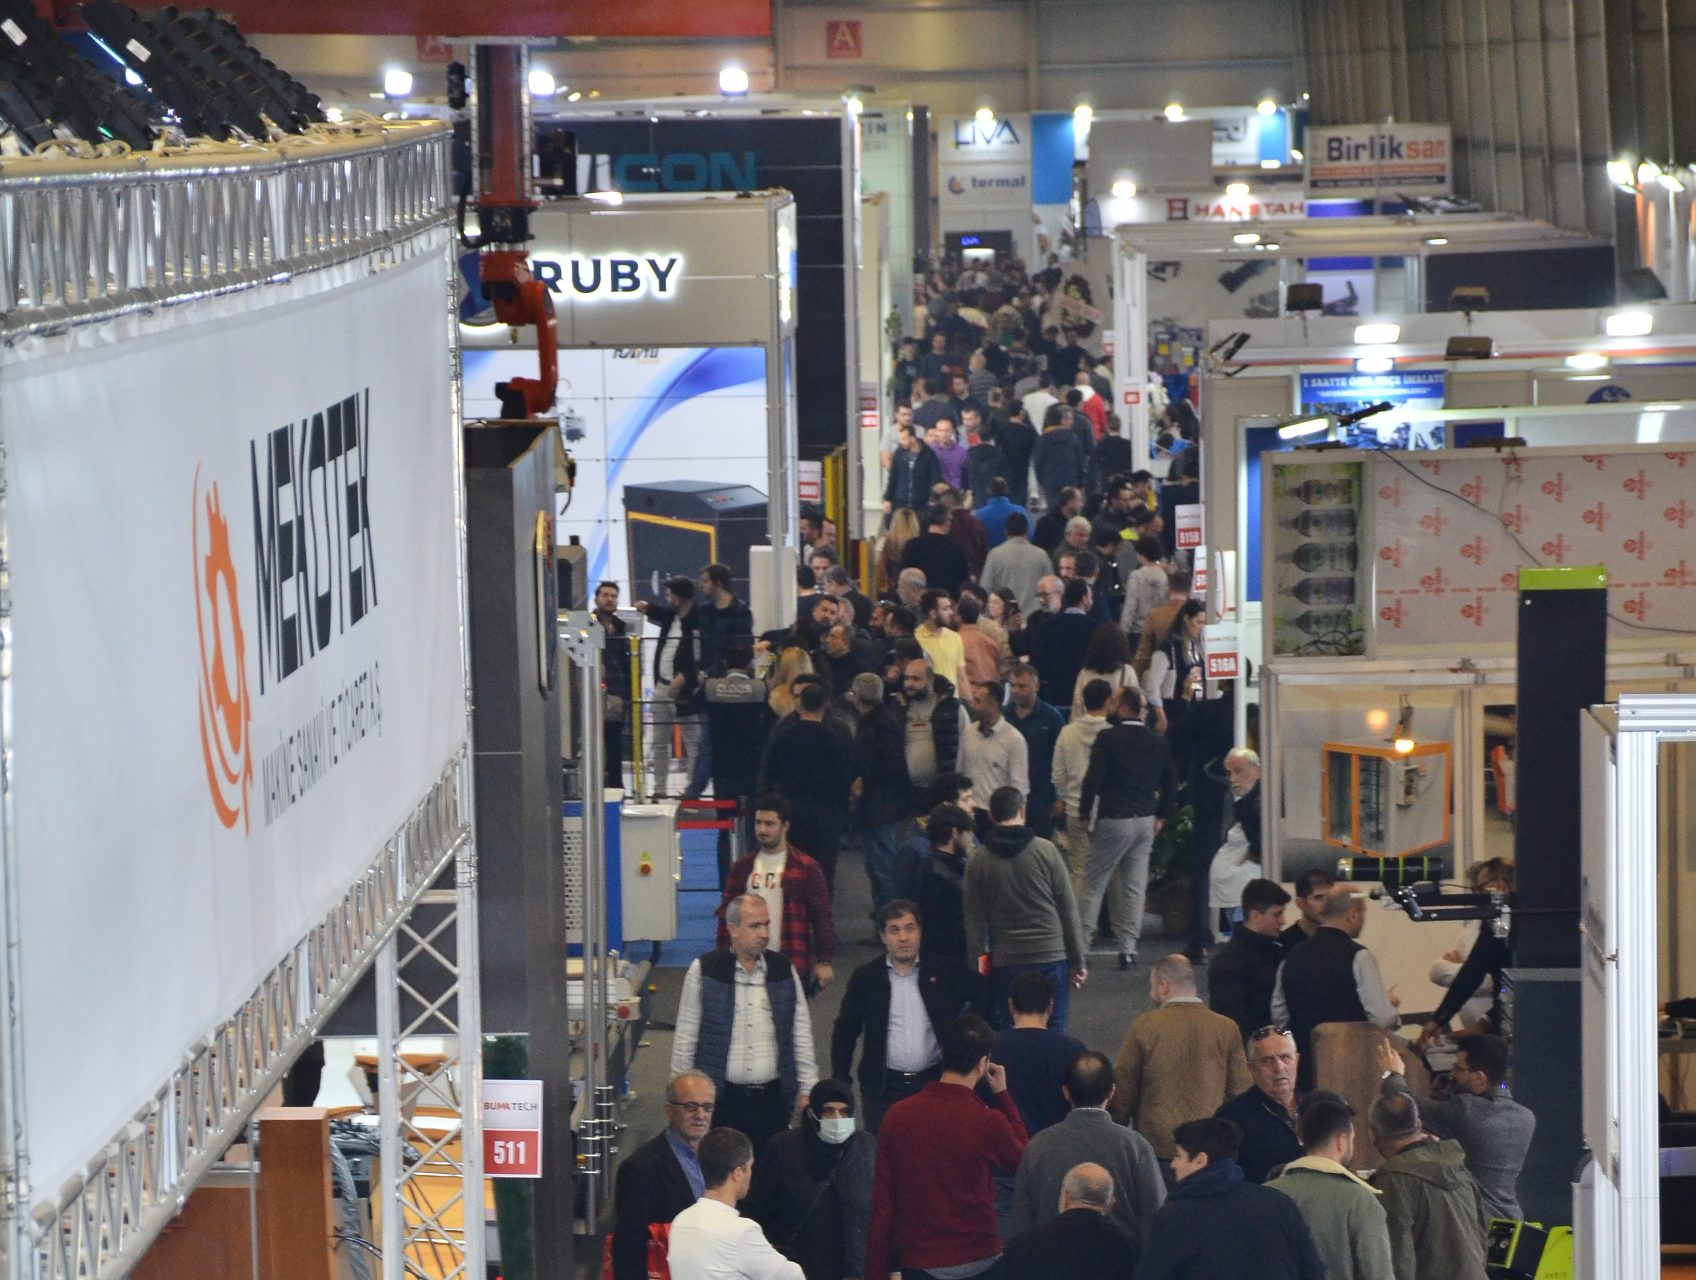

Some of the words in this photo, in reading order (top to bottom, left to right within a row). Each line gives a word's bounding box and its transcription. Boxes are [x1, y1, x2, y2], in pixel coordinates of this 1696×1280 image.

[831, 22, 857, 48] A
[954, 119, 1020, 146] LIVA
[1327, 135, 1446, 161] Birliksan
[971, 175, 1026, 189] termal
[532, 257, 678, 294] RUBY
[249, 386, 378, 697] MEKOTEK
[493, 1140, 527, 1165] 511
